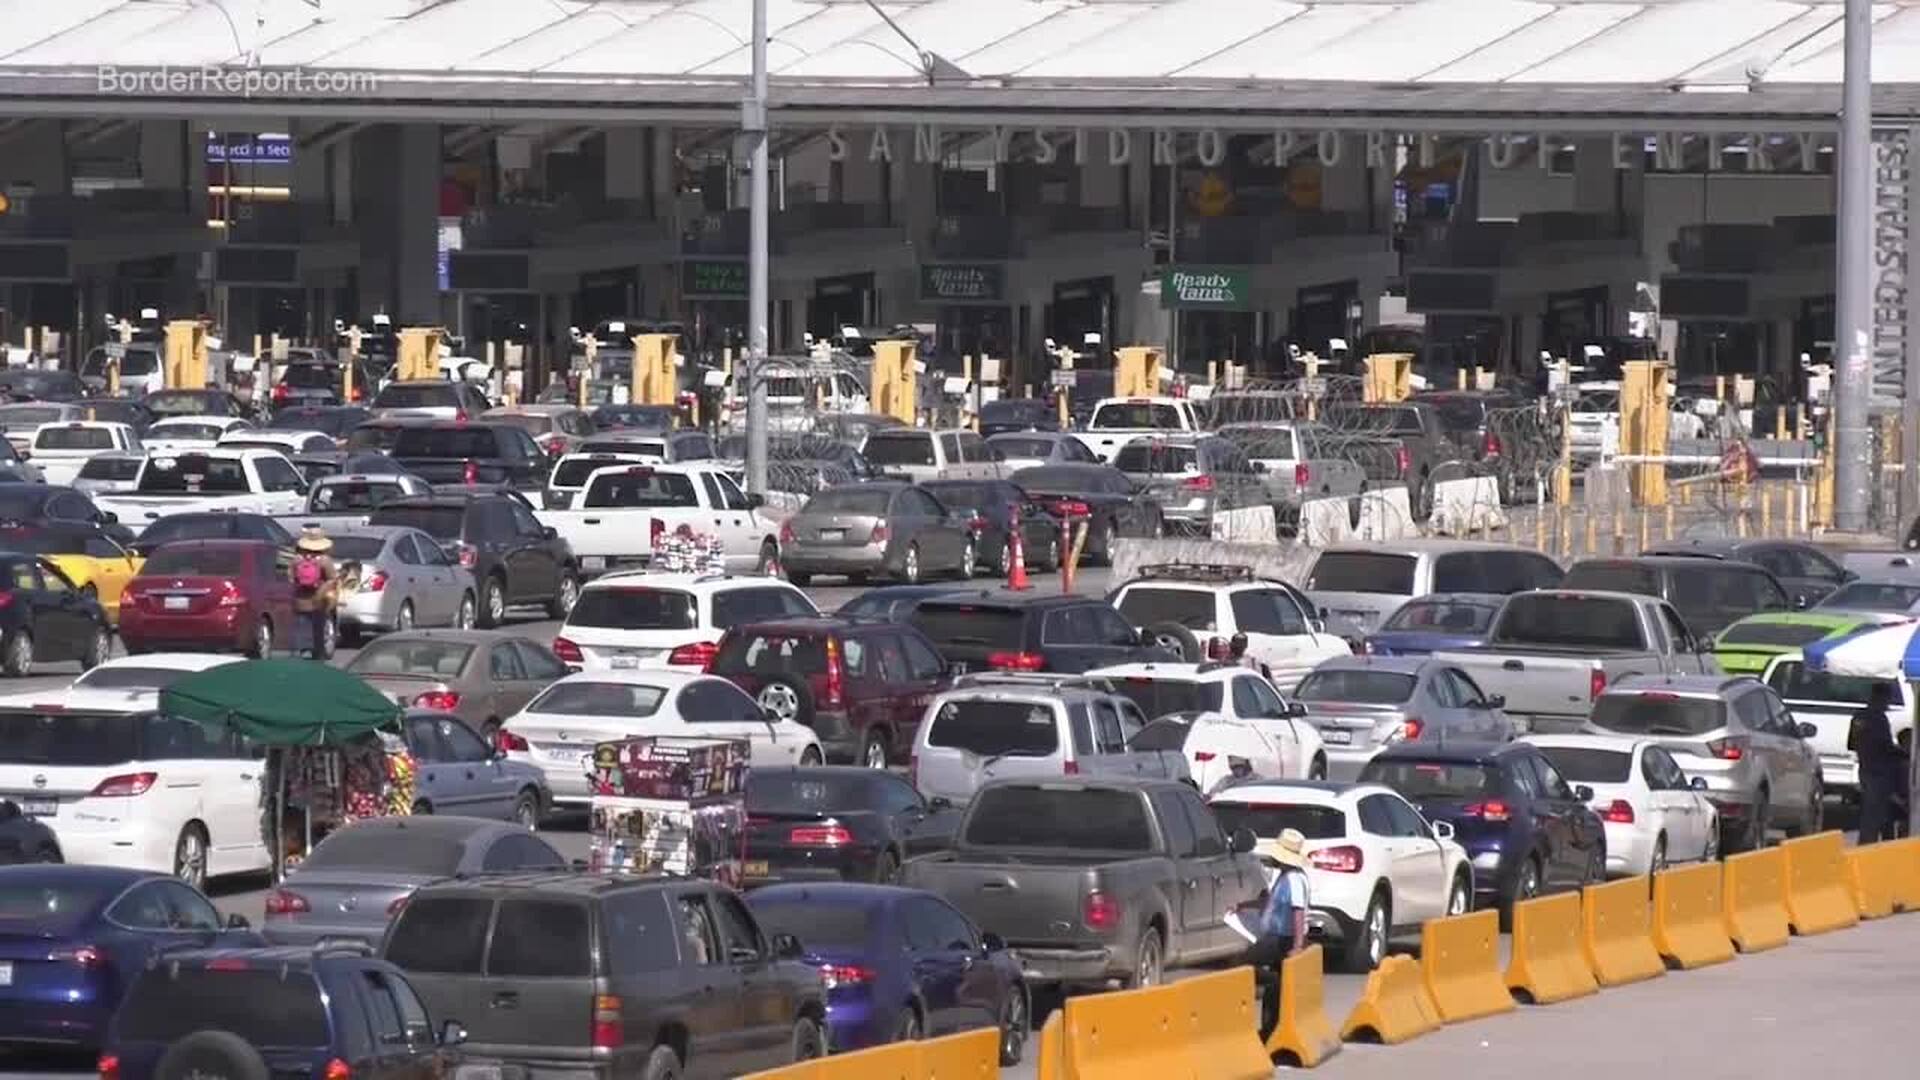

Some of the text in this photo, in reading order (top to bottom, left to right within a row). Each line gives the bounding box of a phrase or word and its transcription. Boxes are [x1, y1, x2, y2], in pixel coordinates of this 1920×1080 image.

[828, 126, 1822, 170] SAN YSIDRO PORT OF ENTRY
[1172, 272, 1231, 289] Ready
[1873, 144, 1908, 400] UNITED STATES
